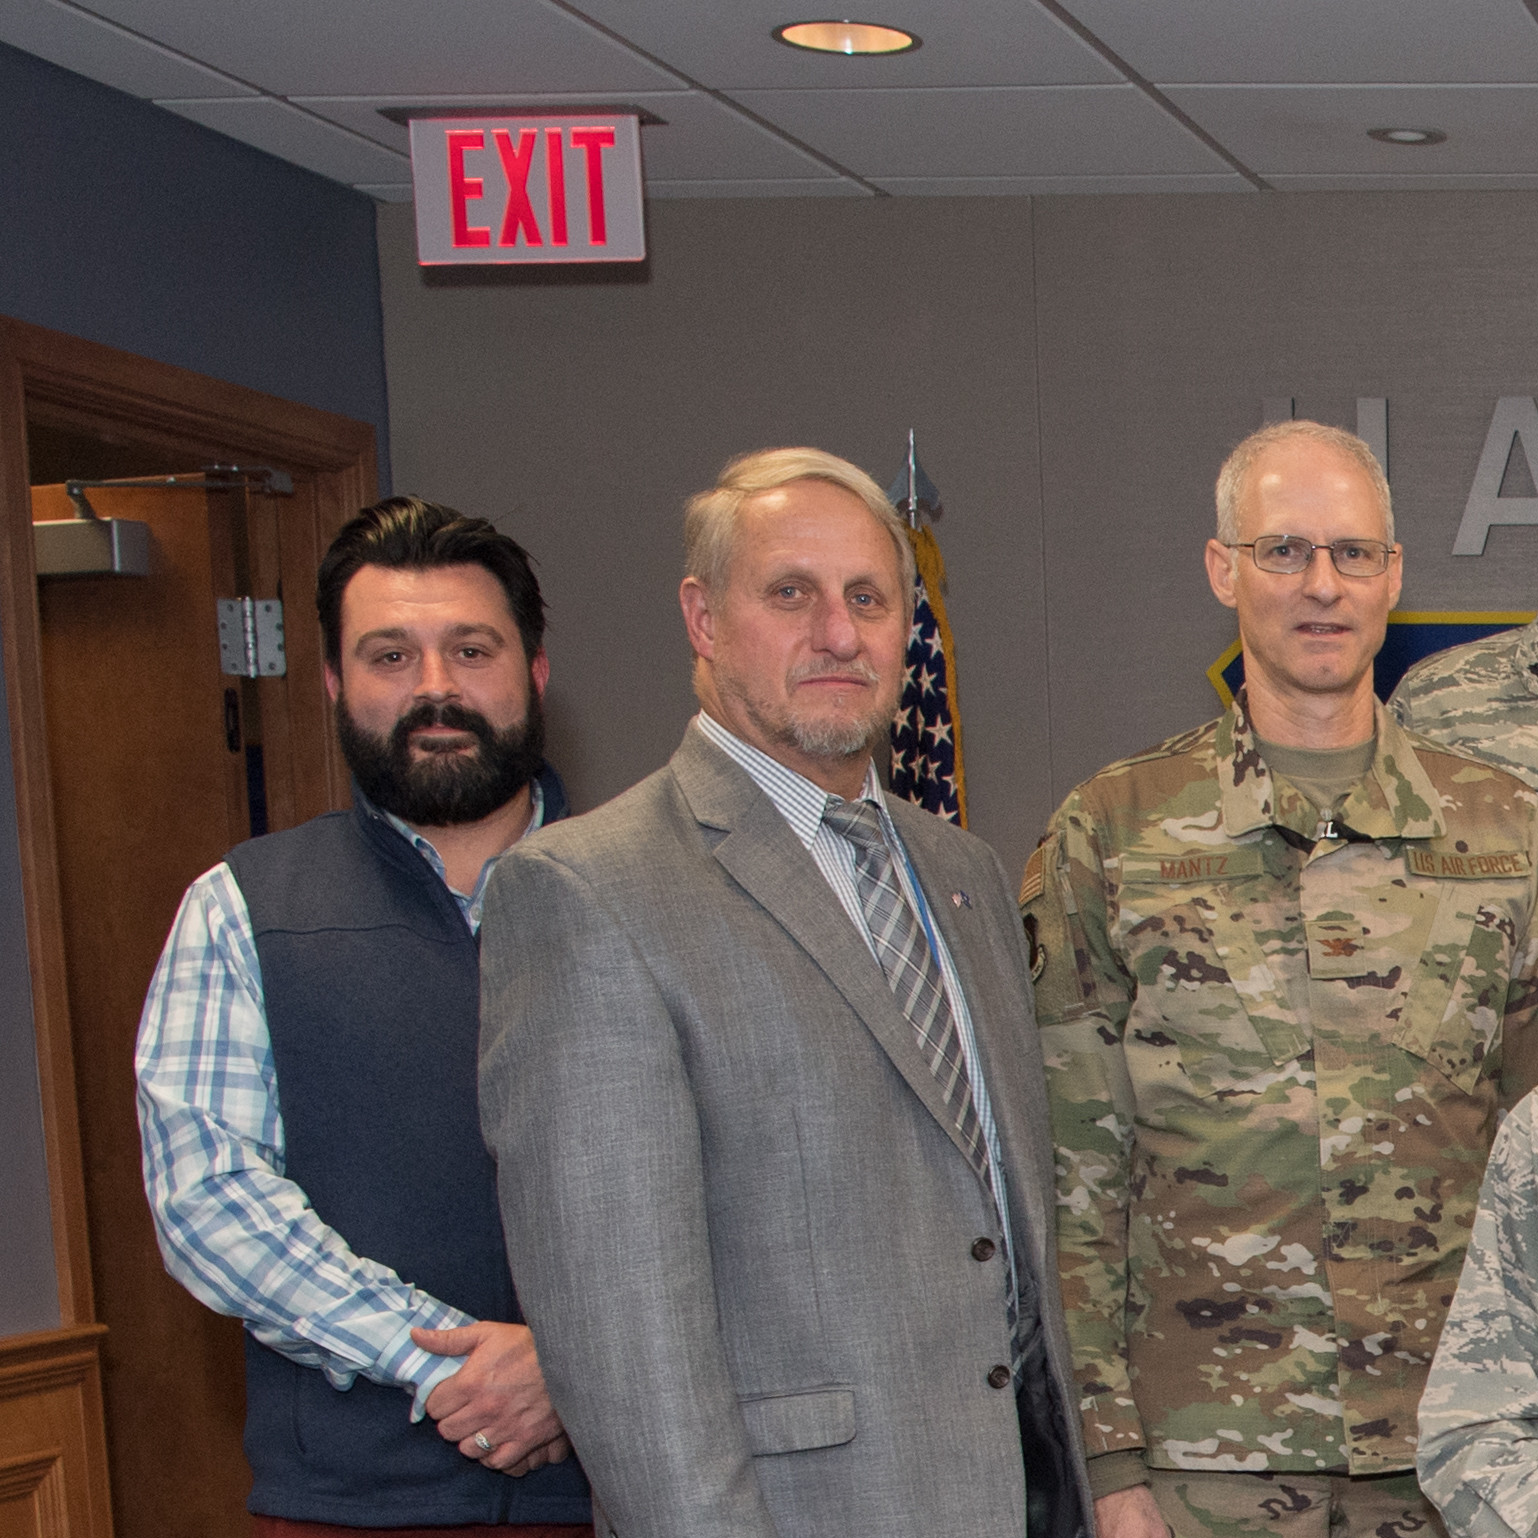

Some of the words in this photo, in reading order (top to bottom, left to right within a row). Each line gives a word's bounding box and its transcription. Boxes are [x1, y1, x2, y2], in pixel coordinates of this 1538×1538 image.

[445, 126, 616, 248] EXIT
[1160, 855, 1229, 878] MANTZ
[1413, 850, 1435, 873] US
[1441, 855, 1467, 876] AIR
[1467, 853, 1523, 875] FORCE
